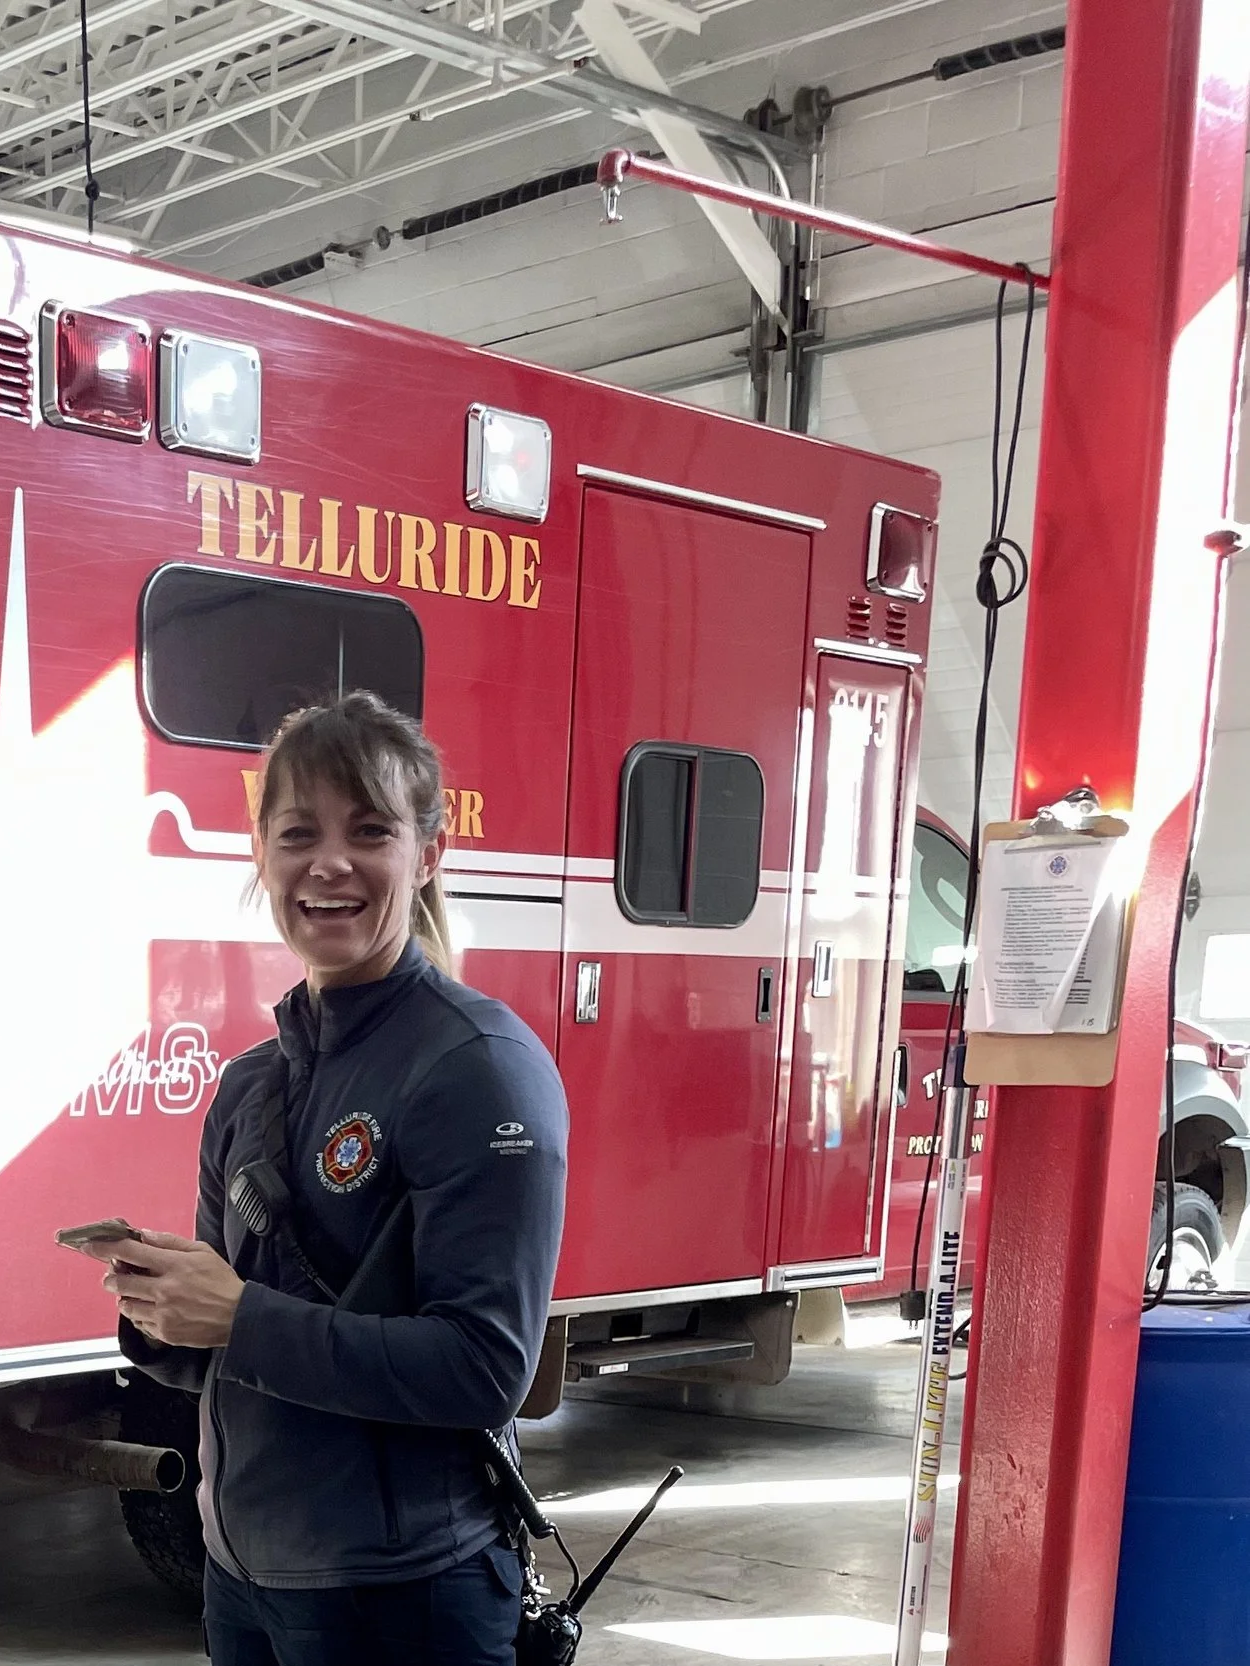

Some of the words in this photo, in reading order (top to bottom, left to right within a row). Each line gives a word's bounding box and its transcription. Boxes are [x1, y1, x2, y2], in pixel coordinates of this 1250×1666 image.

[187, 470, 543, 609] TELLURIDE
[368, 1118, 383, 1142] FIRE
[315, 1152, 346, 1194] PROTECTION
[345, 1156, 381, 1193] DISTRICT
